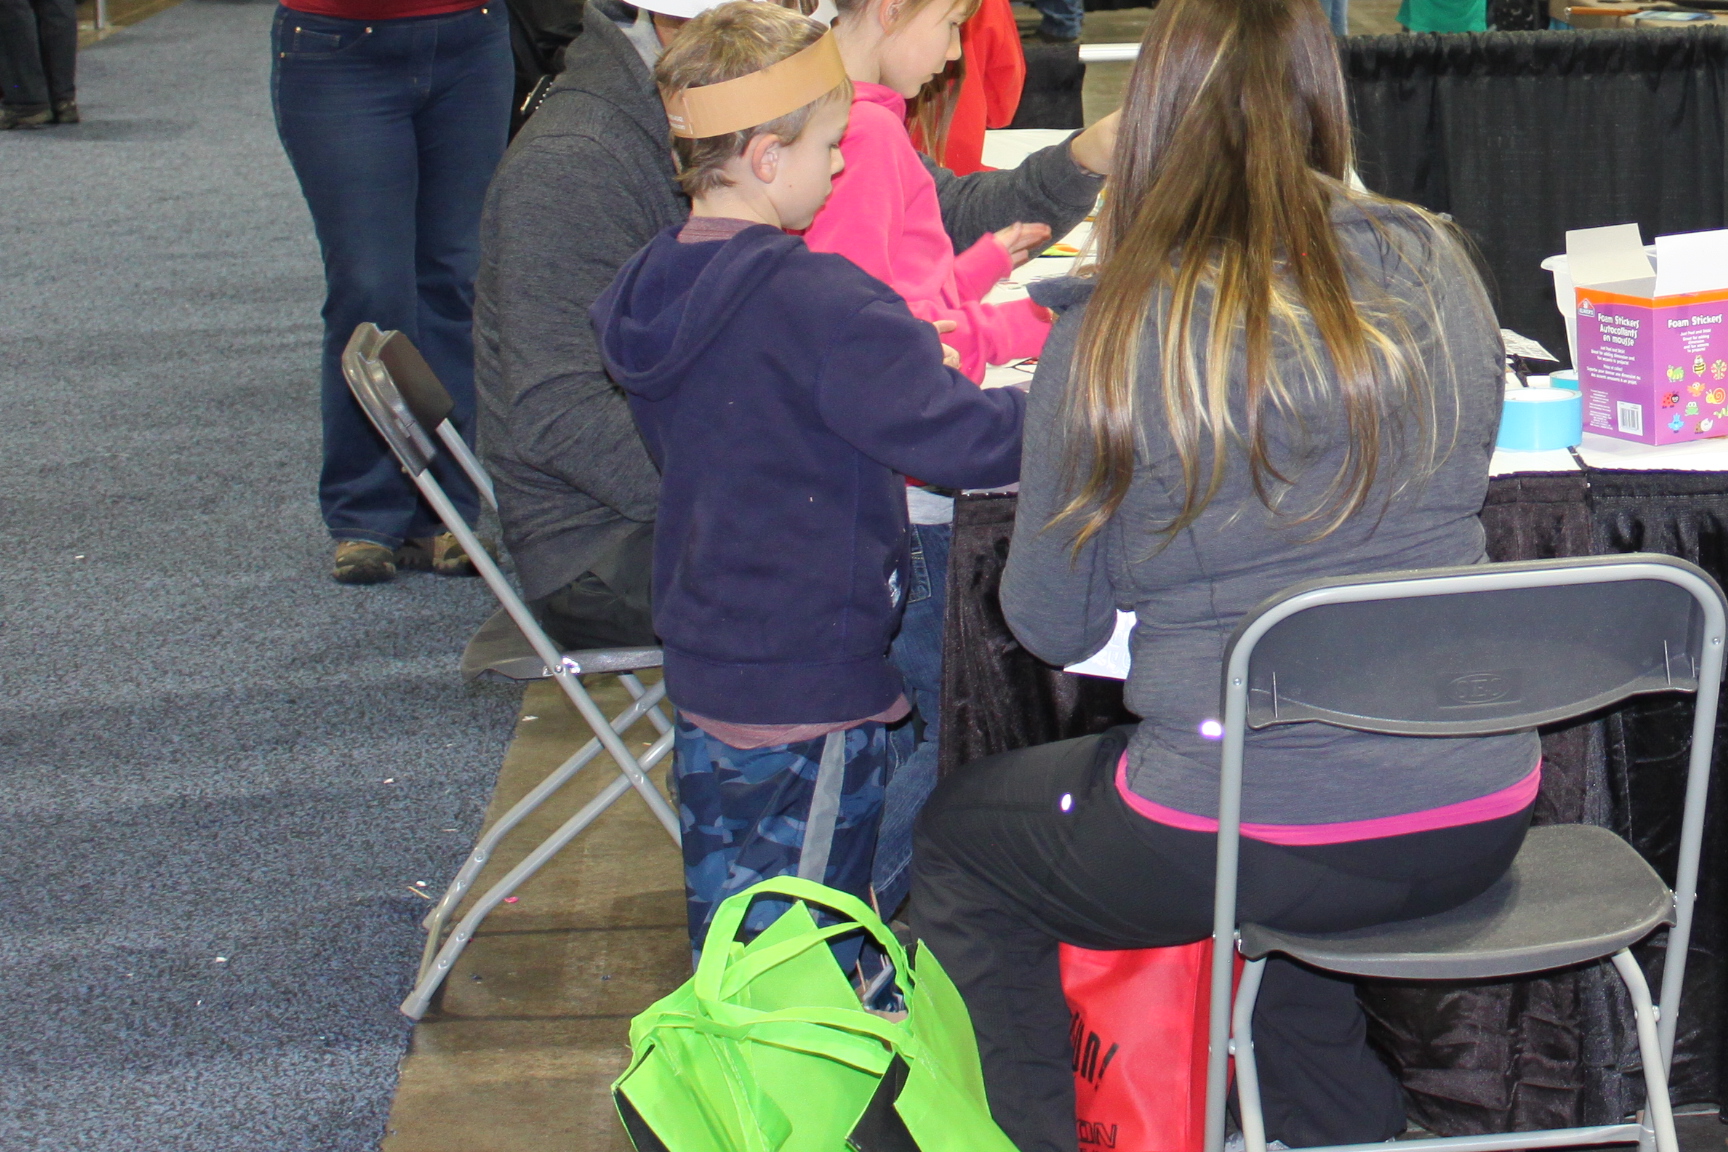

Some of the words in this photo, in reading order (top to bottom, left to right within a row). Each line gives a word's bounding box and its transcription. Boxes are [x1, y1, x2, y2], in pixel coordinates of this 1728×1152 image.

[1597, 313, 1614, 323] Foam
[1614, 315, 1640, 329] Stickers
[1668, 319, 1689, 328] Foam
[1691, 314, 1722, 326] Stickers
[1600, 324, 1638, 339] Autocollants
[1603, 334, 1611, 342] en
[1612, 336, 1635, 347] mousse
